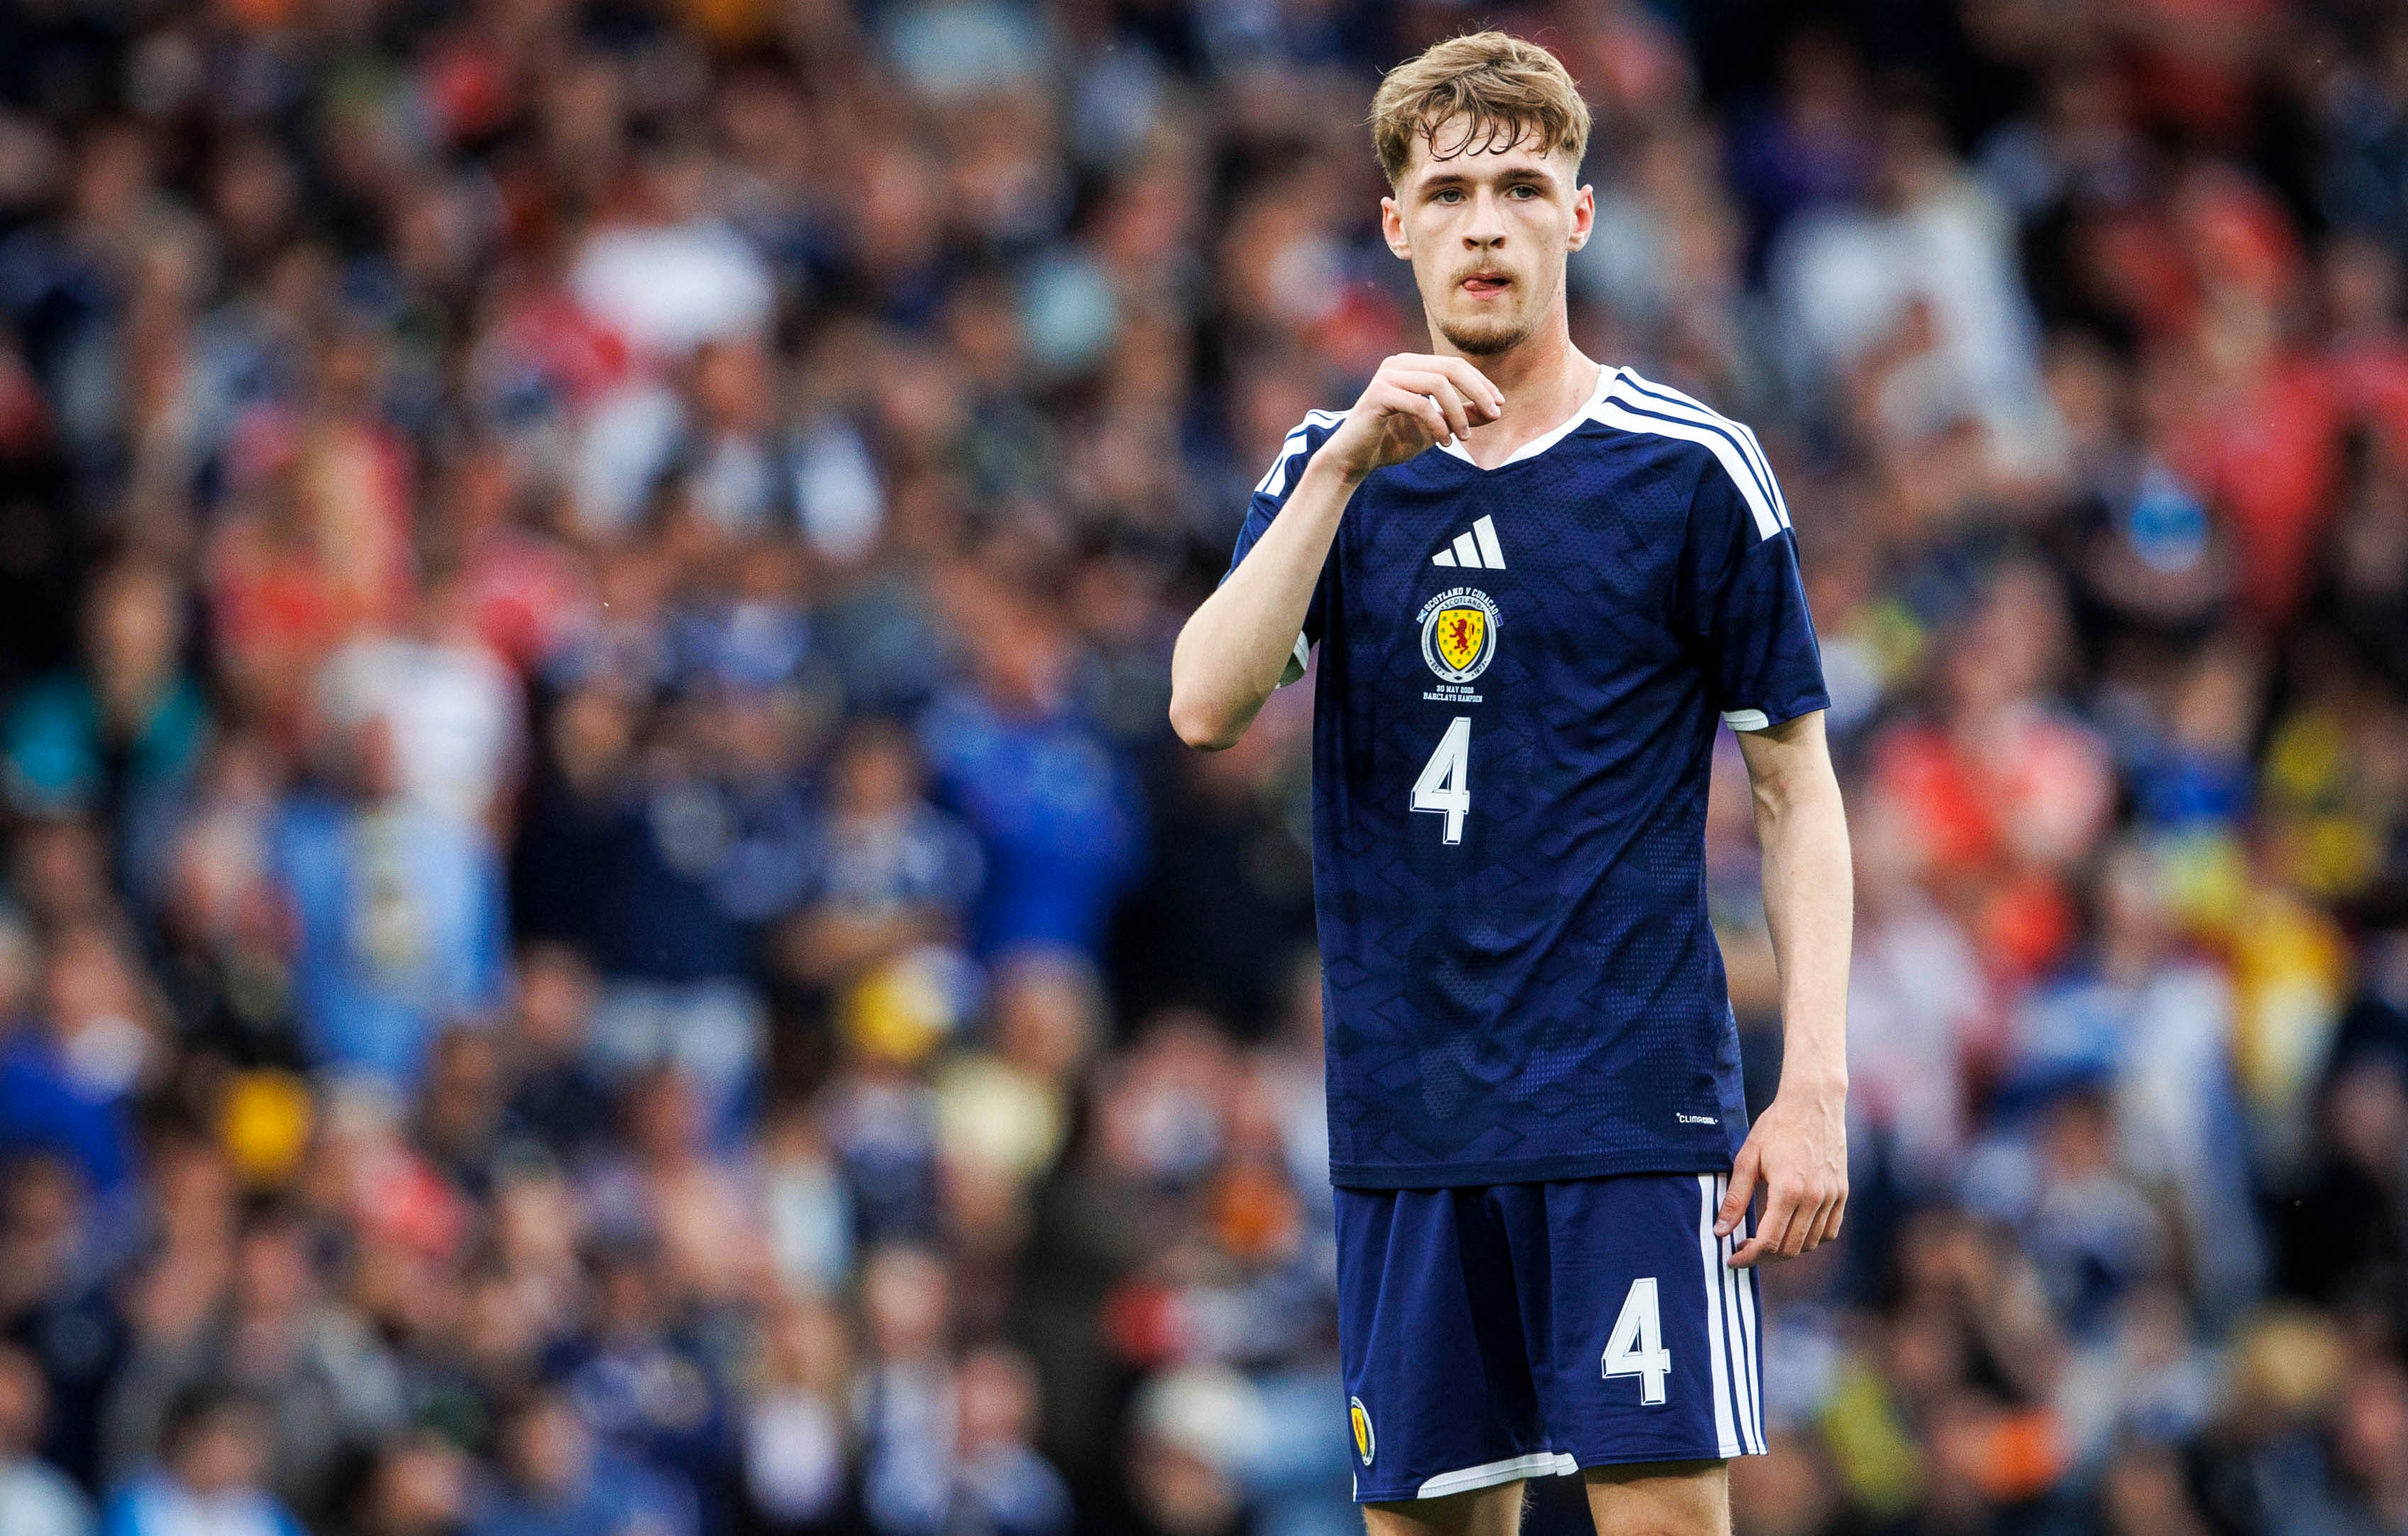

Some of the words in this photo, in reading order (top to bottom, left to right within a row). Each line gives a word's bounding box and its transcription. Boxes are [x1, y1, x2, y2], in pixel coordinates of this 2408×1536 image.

[1424, 587, 1464, 612] SCOTLAND
[1466, 587, 1471, 596] V
[1445, 597, 1481, 609] SCOTLAND
[1431, 662, 1442, 673] EST
[1474, 663, 1486, 675] 1873
[1423, 692, 1457, 702] BARCLAYS
[1457, 694, 1483, 703] HAMPDEN
[1410, 717, 1471, 845] 4
[1601, 1277, 1671, 1405] 4
